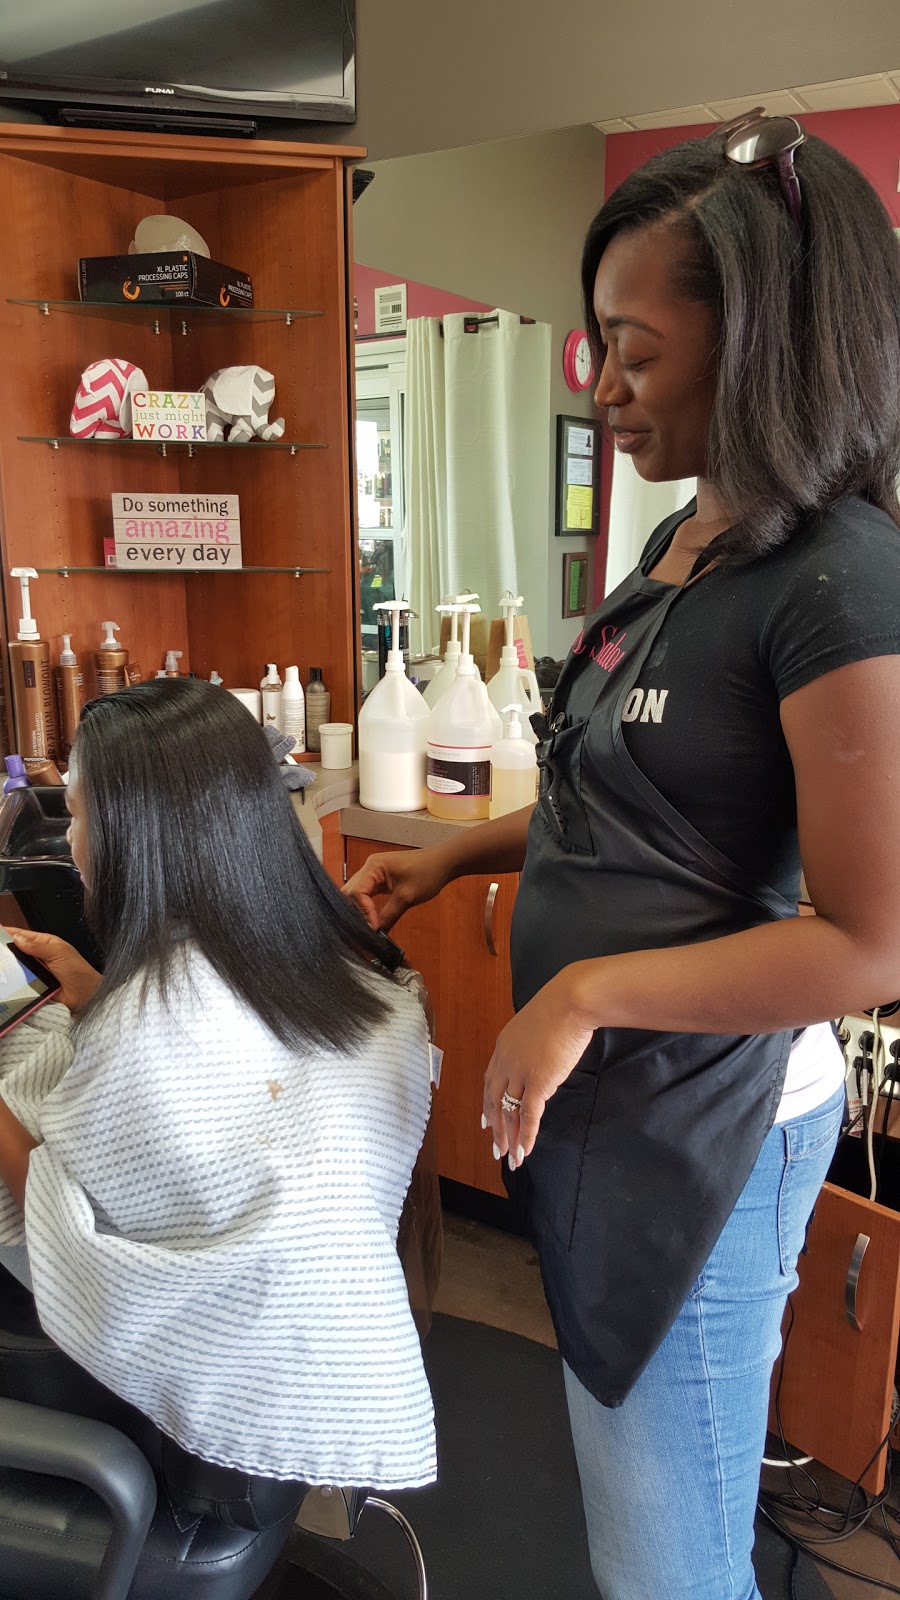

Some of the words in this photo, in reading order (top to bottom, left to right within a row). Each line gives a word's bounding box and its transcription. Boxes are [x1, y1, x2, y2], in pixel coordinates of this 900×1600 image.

[165, 264, 188, 272] PLASTIC
[138, 273, 172, 281] PROCESSING
[133, 393, 202, 409] CRAZY
[134, 410, 161, 422] just
[165, 410, 205, 424] might
[134, 424, 205, 440] WORK
[123, 497, 144, 512] Do
[148, 498, 229, 517] something
[125, 516, 230, 545] amazing
[126, 546, 186, 565] every
[192, 544, 231, 565] day
[41, 659, 53, 707] BLOWOUT
